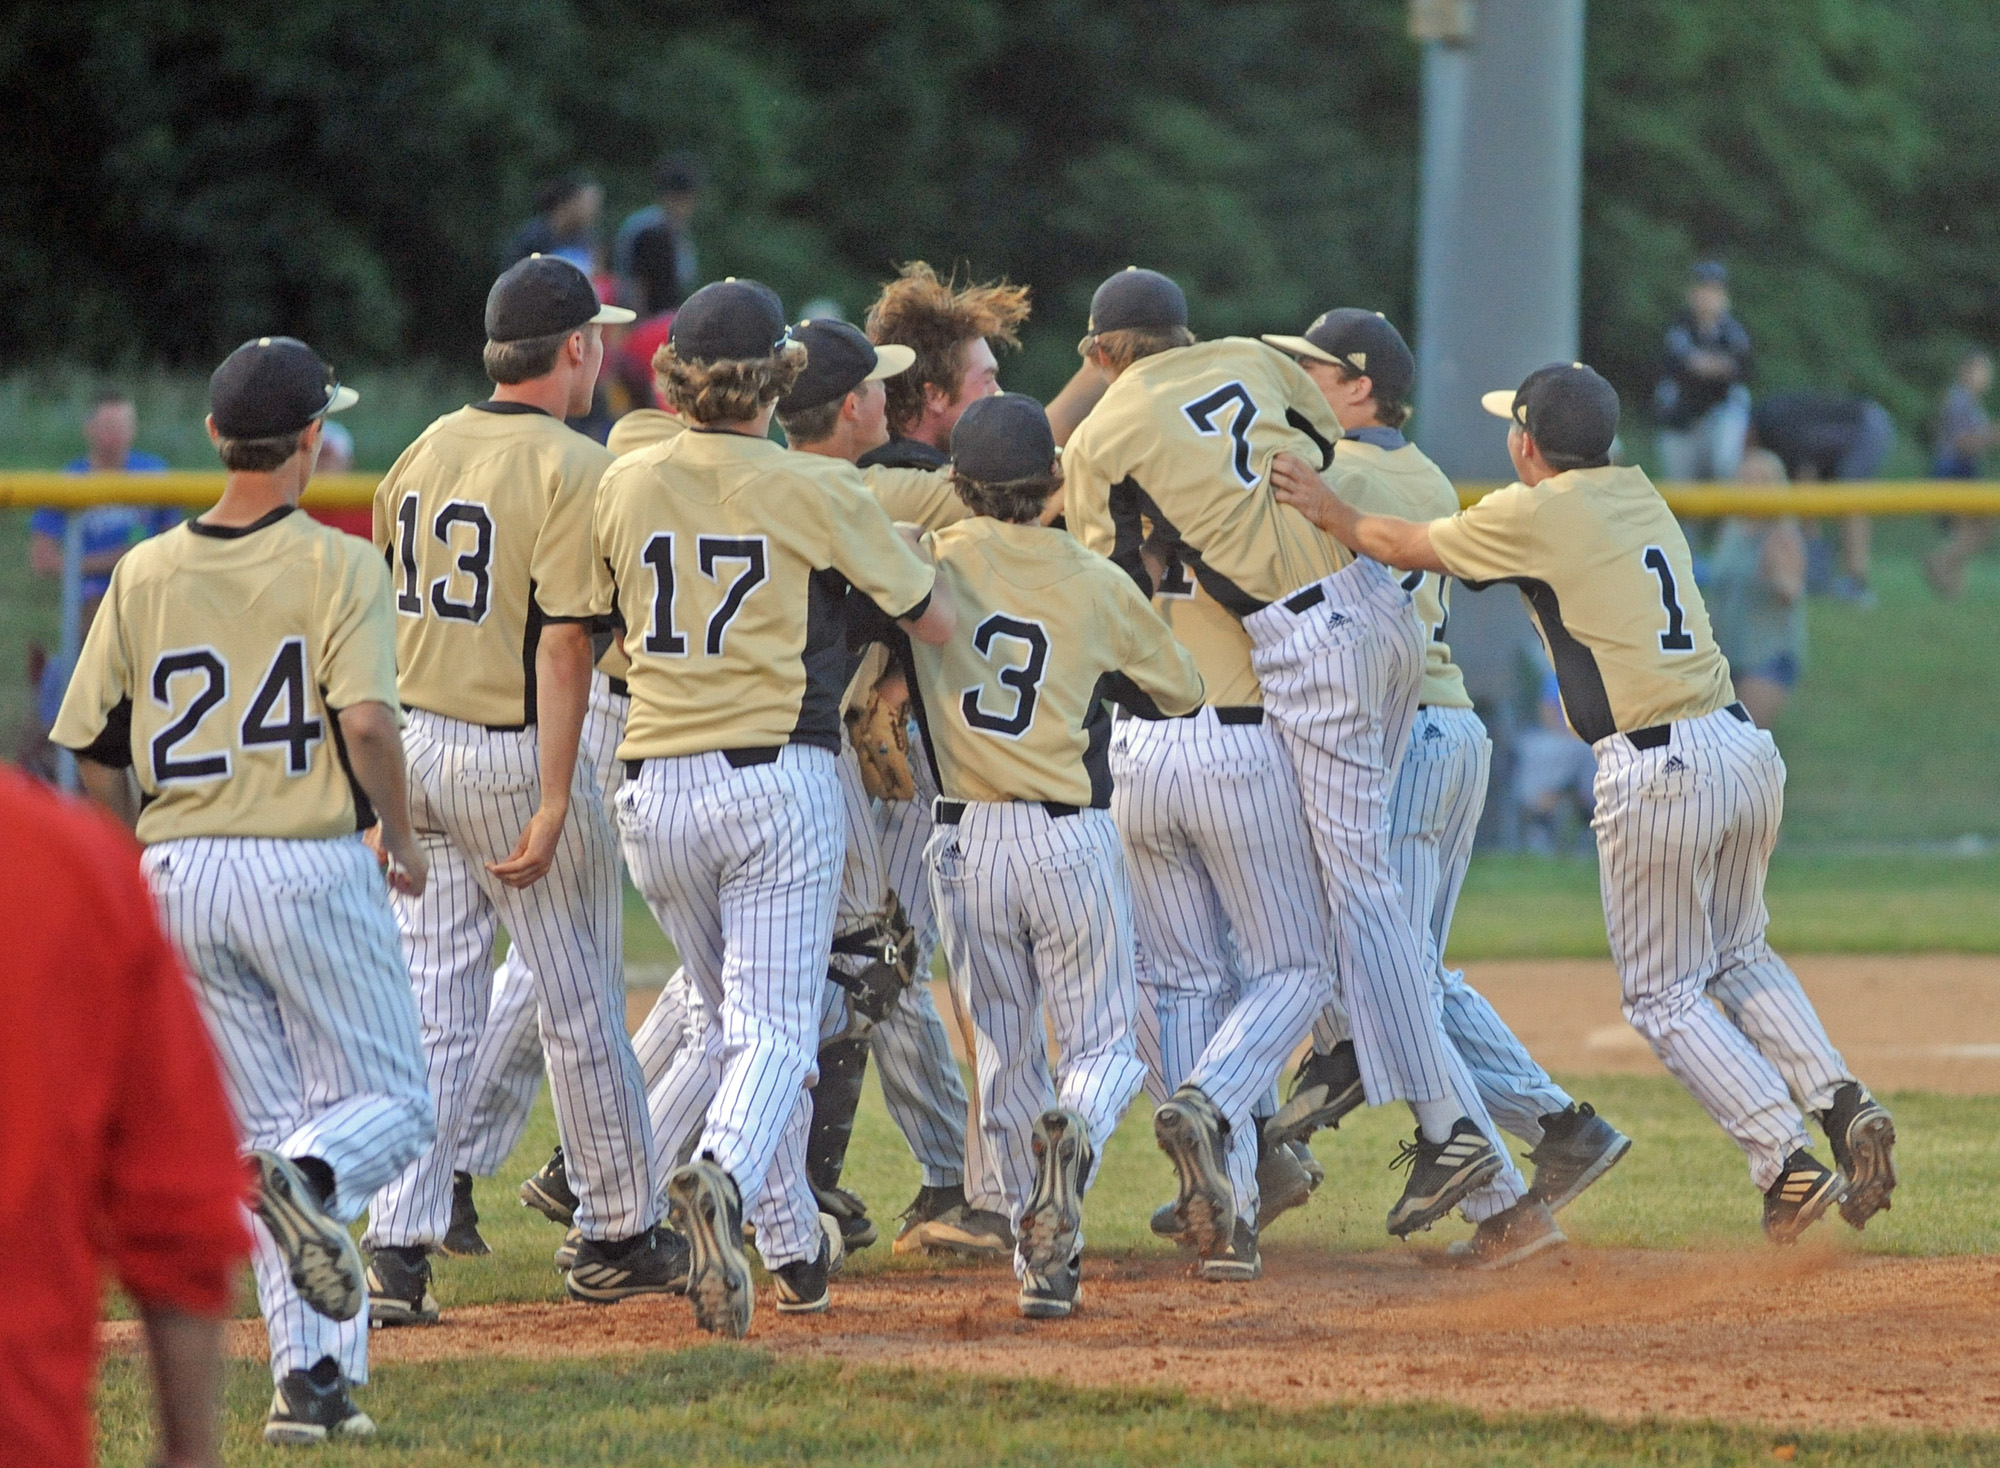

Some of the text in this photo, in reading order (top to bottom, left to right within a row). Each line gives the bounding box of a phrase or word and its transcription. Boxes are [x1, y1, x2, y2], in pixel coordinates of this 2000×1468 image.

[1179, 380, 1261, 490] 7
[396, 490, 497, 627] 13
[641, 531, 769, 657] 17
[1641, 545, 1696, 654] 1
[151, 636, 325, 787] 24
[960, 611, 1052, 741] 3
